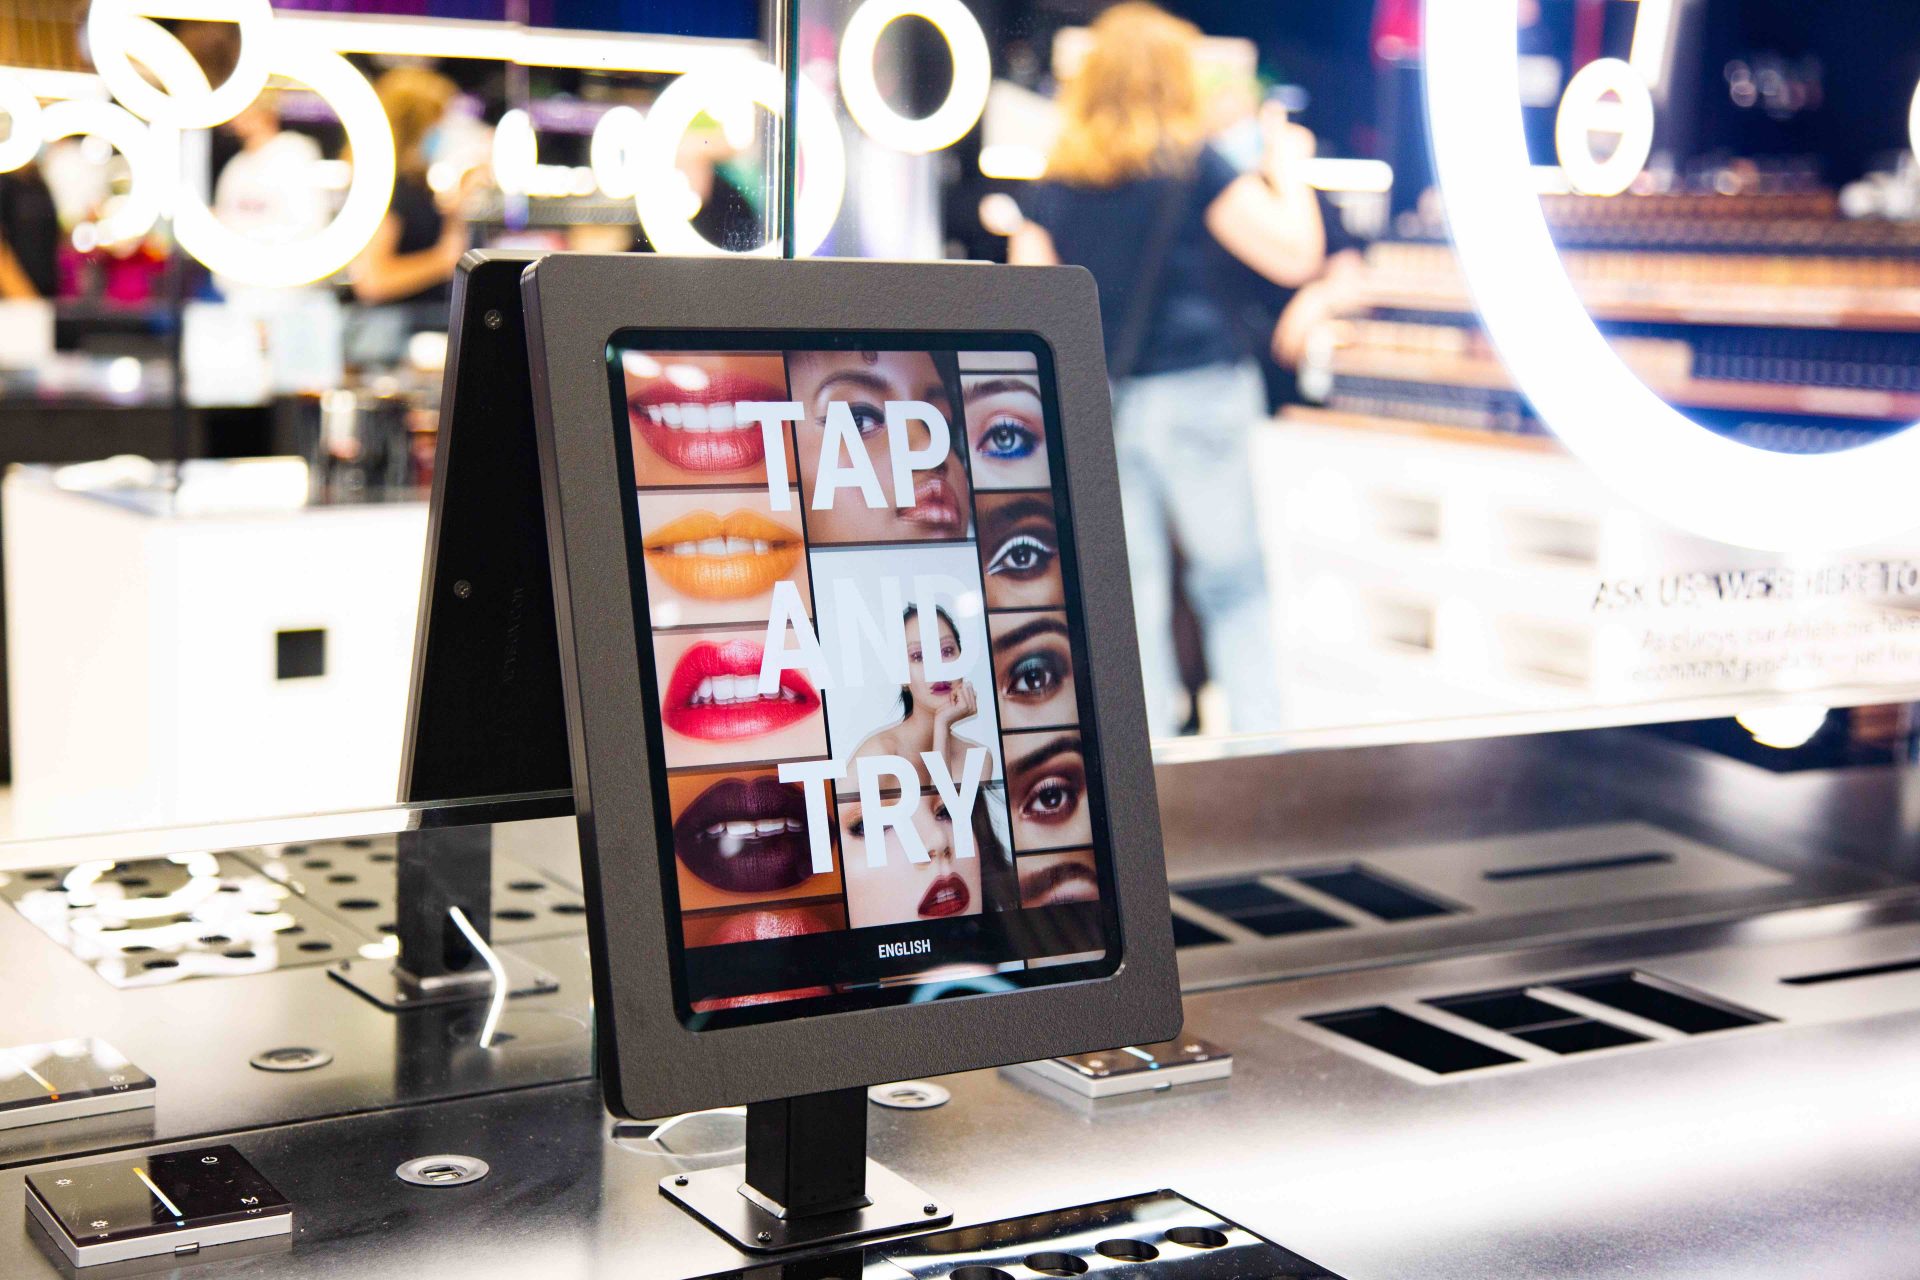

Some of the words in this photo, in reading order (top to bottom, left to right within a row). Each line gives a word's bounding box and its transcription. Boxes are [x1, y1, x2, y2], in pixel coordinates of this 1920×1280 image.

[735, 400, 951, 512] TAP
[756, 573, 980, 694] AND
[778, 747, 988, 874] TRY
[877, 938, 931, 959] ENGLISH
